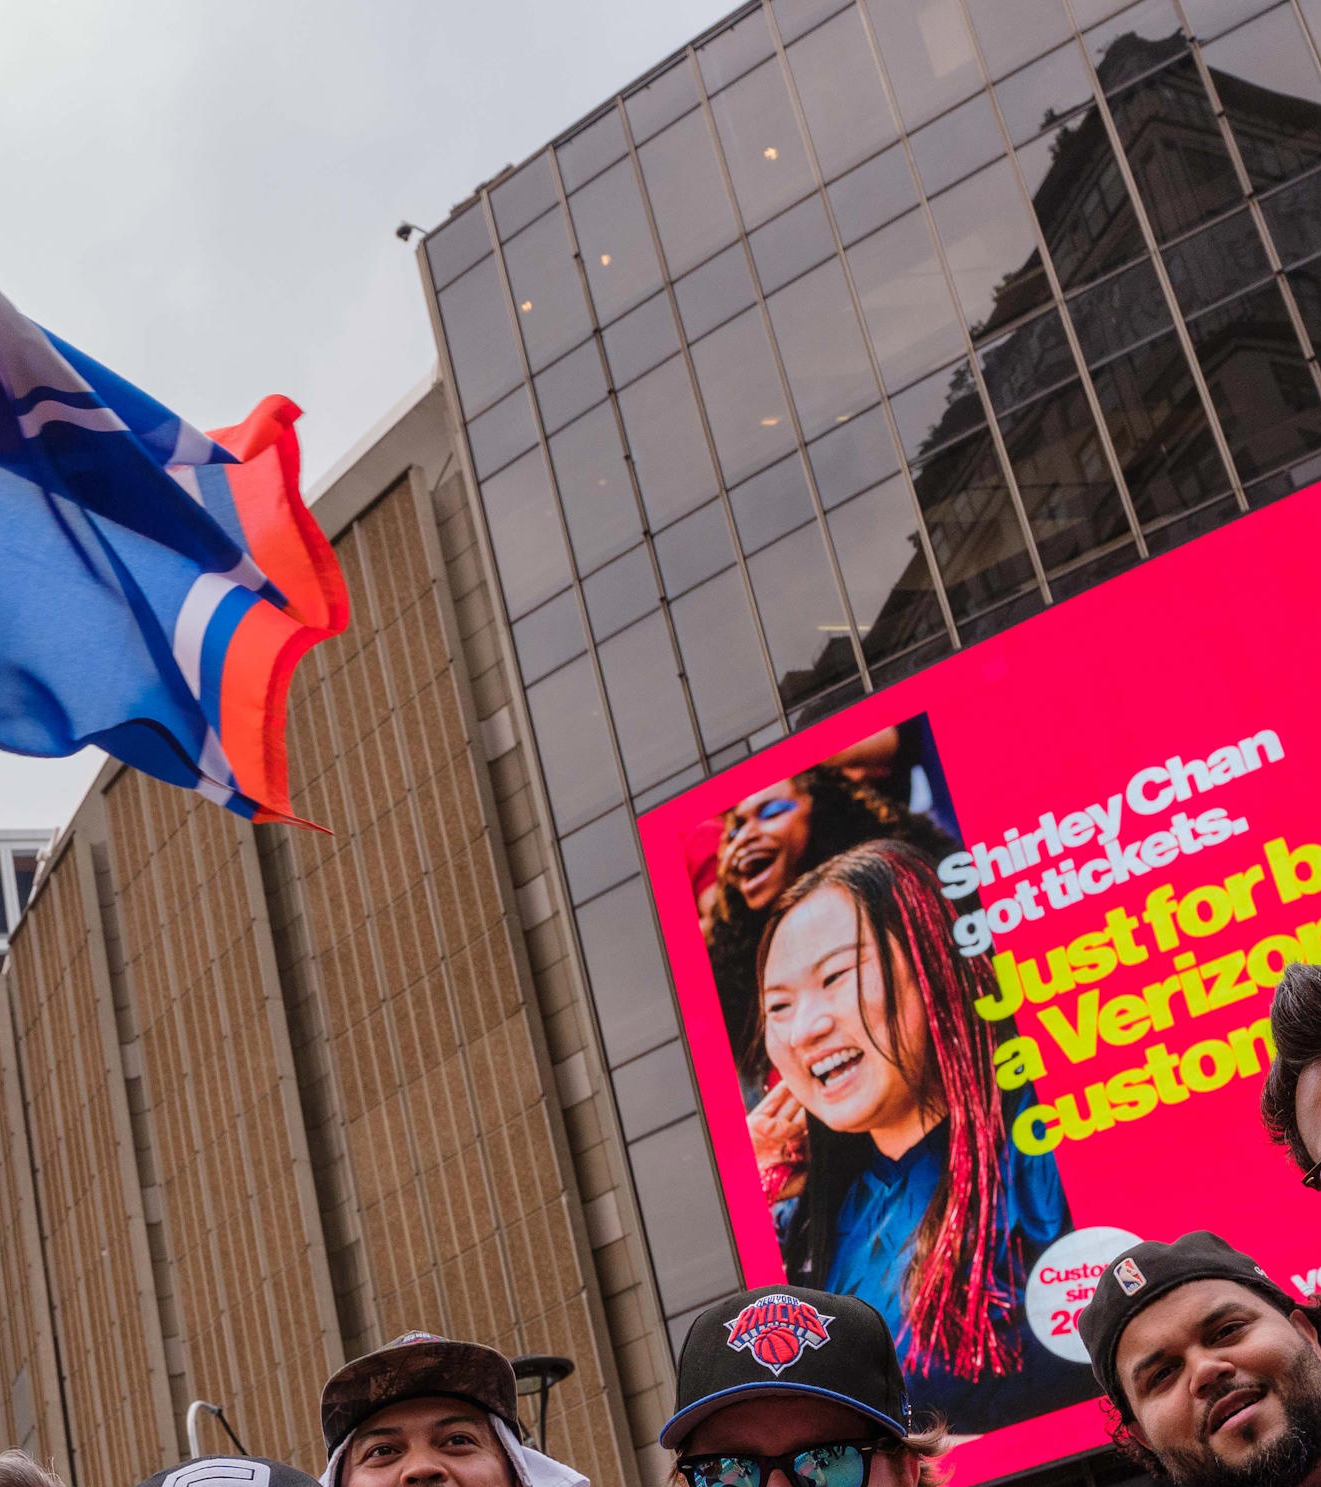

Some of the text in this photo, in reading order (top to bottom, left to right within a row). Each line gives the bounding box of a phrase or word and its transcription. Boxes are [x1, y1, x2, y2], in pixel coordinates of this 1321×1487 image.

[937, 729, 1285, 899] Shirley Chan
[953, 806, 1249, 957] got tickets.
[974, 907, 1148, 1022] Just
[1143, 864, 1268, 952] for
[994, 1034, 1047, 1091] a
[1039, 1263, 1110, 1285] Custo
[1066, 1284, 1096, 1302] sin
[728, 1303, 828, 1344] KNICKS
